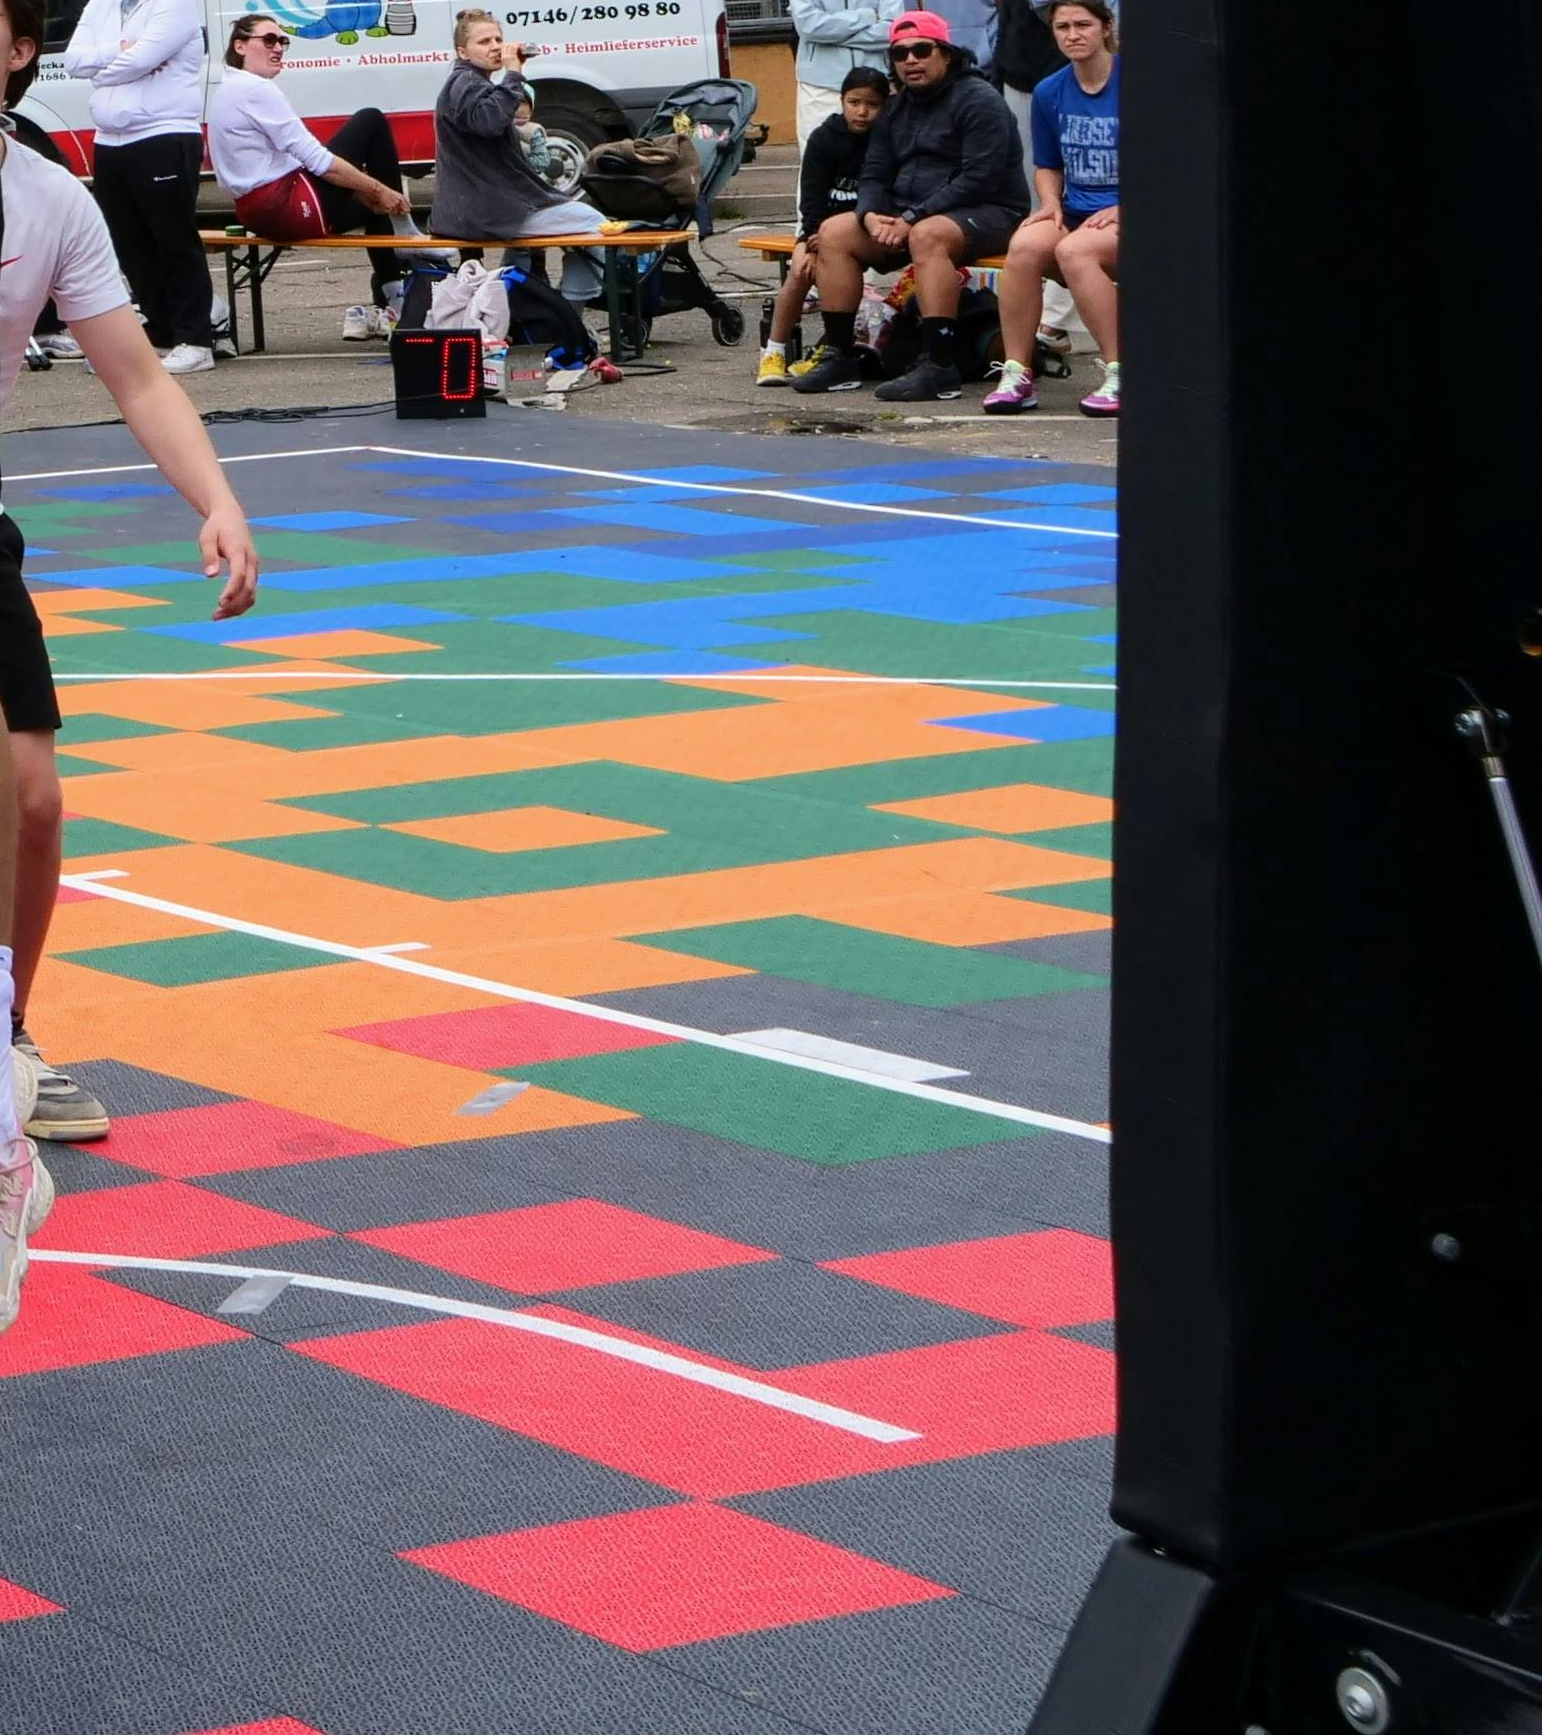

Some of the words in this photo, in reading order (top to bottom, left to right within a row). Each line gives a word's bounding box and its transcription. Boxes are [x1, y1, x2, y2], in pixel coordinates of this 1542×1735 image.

[625, 3, 650, 21] 98
[656, 1, 682, 16] 80
[565, 36, 699, 55] Heimlieferservice
[358, 51, 451, 66] Abholmarkt
